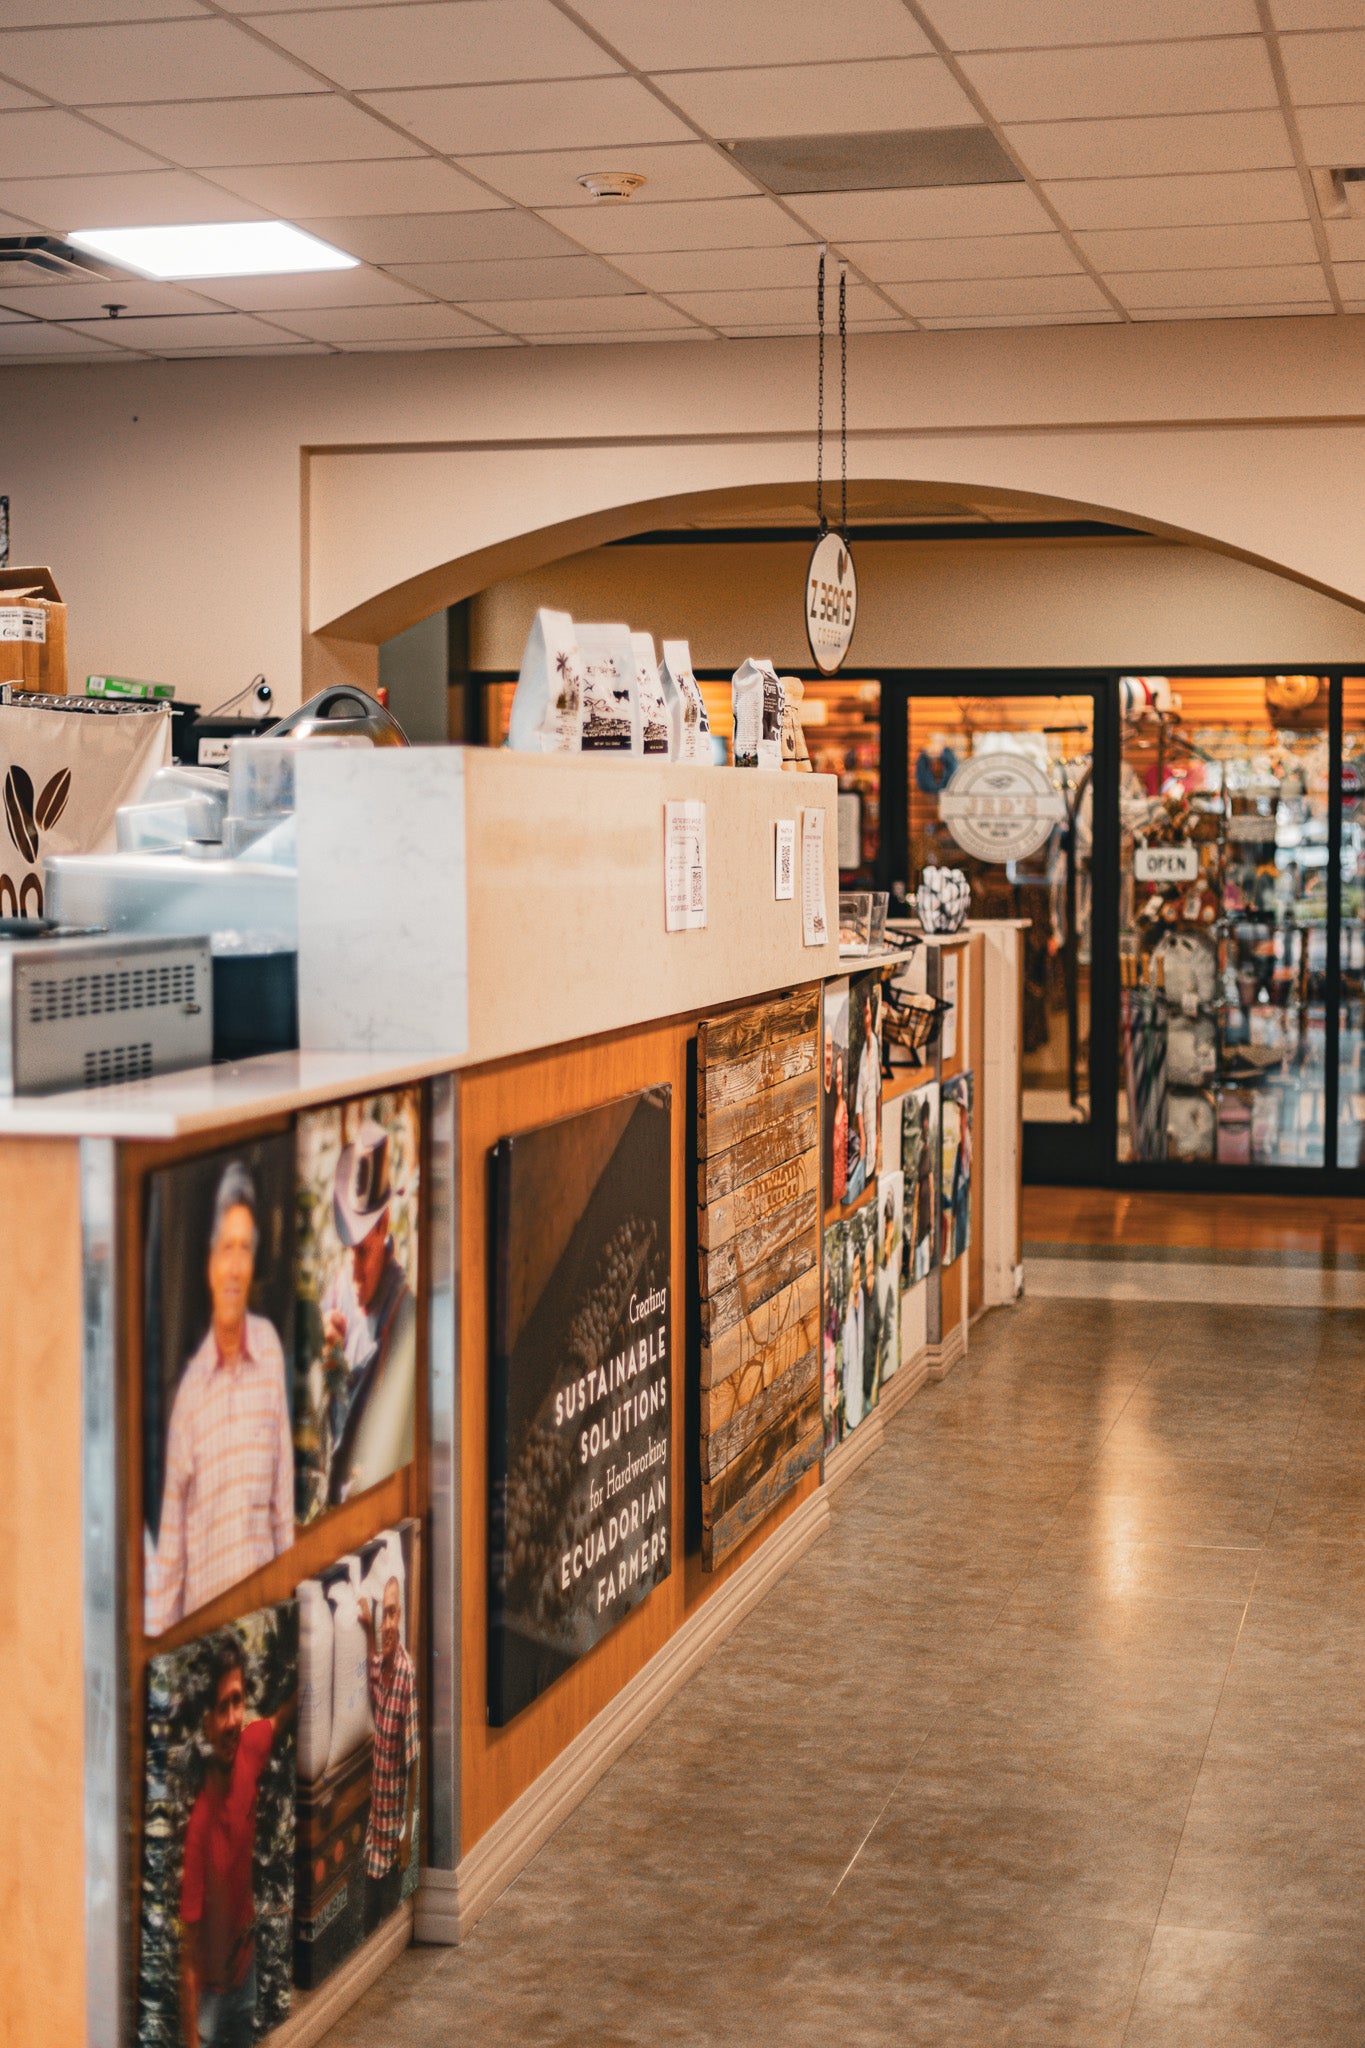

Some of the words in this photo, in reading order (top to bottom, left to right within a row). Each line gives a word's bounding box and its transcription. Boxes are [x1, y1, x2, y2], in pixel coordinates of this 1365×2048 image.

[1147, 856, 1187, 872] OPEN
[629, 1287, 667, 1324] Creating
[555, 1325, 666, 1426] SUSTAINABLE
[581, 1376, 666, 1464] SOLUTIONS
[589, 1478, 604, 1512] for
[606, 1436, 668, 1501] Hardworking
[561, 1475, 666, 1590] ECUADORIAN
[597, 1525, 666, 1613] FARMERS
